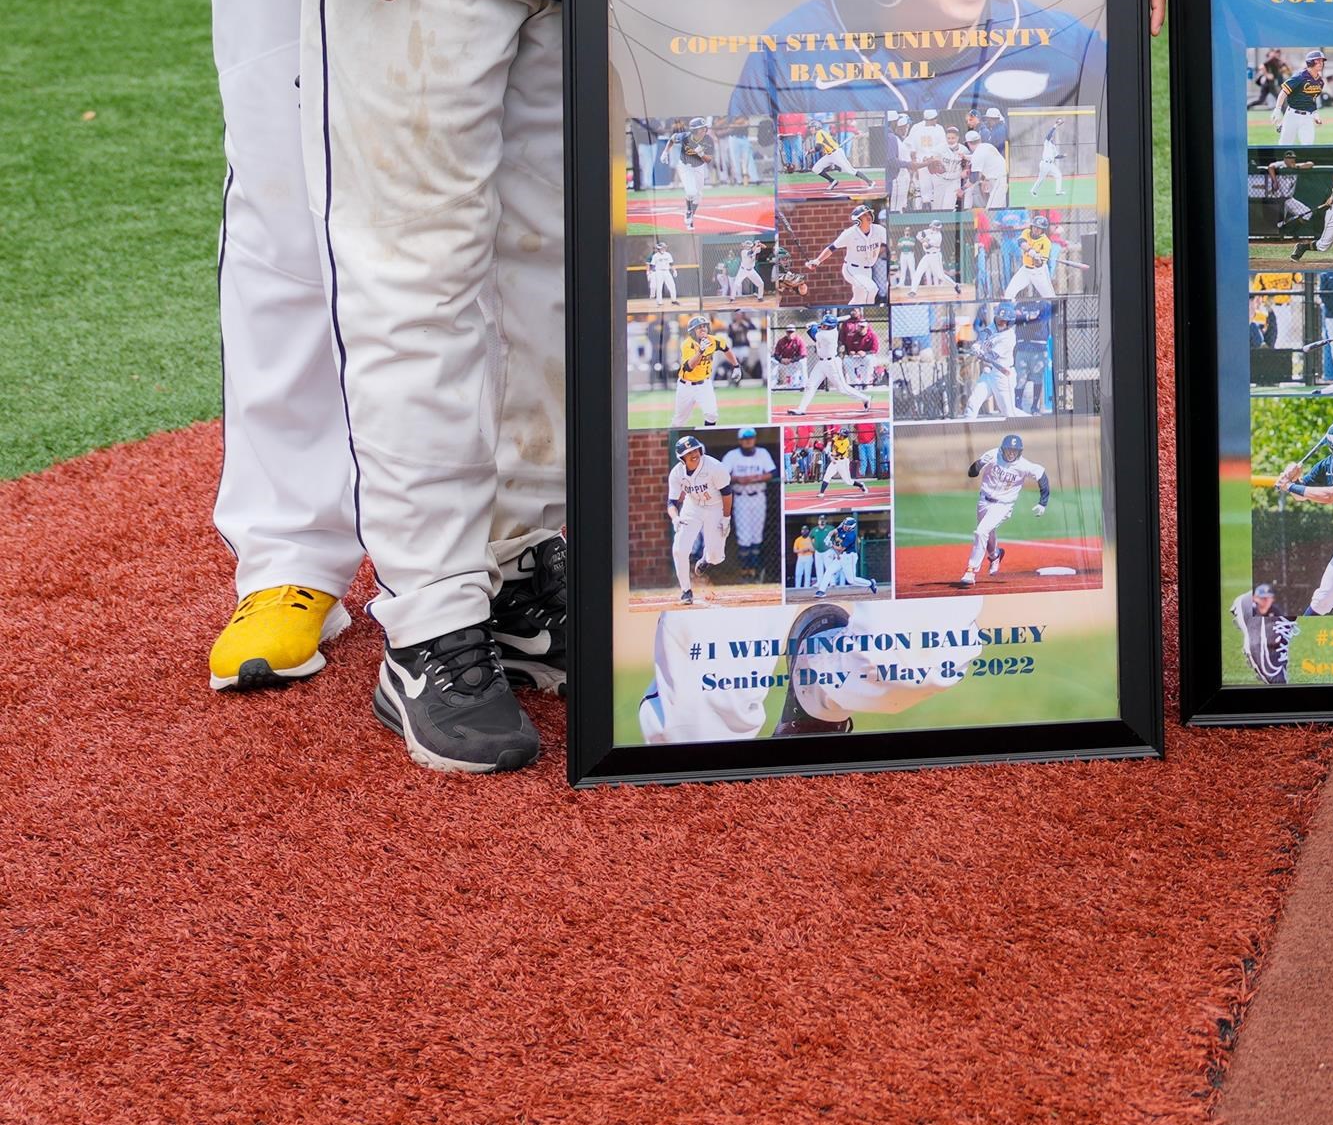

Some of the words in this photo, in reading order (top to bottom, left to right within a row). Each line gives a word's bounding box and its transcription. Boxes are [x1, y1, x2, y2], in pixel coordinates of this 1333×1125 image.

[669, 34, 778, 55] COPPIN
[786, 32, 876, 53] STATE
[884, 28, 1055, 50] UNIVERSITY
[789, 60, 936, 82] BASEBALL
[729, 633, 912, 659] WELLINGTON
[921, 625, 1048, 648] BALSLEY
[701, 671, 790, 692] Senior
[800, 667, 852, 688] Day
[876, 663, 927, 685] May
[941, 660, 965, 680] 8,
[972, 656, 1035, 677] 2022
